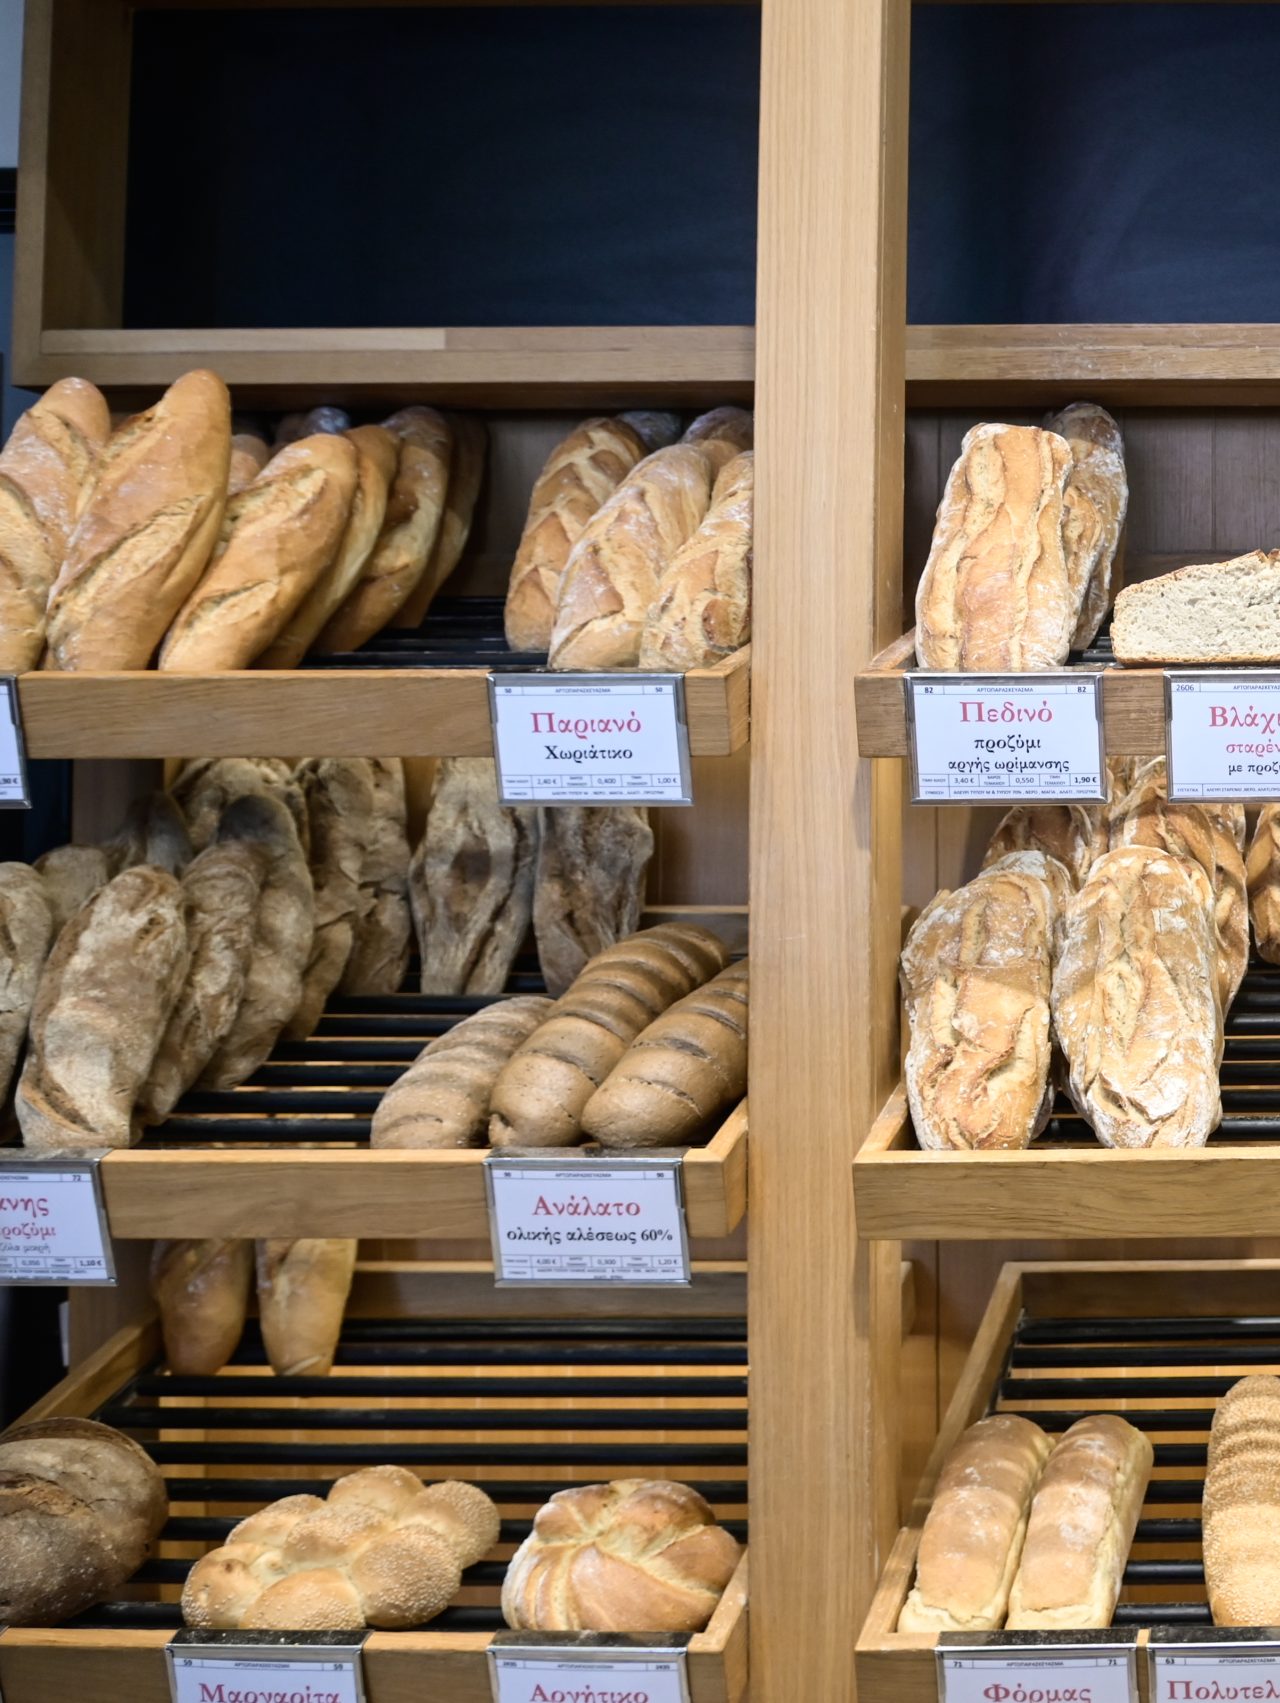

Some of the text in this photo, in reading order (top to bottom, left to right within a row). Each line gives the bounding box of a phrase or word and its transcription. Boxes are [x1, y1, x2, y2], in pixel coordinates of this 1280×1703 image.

[959, 700, 1053, 723] Πεδινό
[530, 711, 641, 739] Παριανό
[974, 734, 1041, 753] προζύμι
[544, 745, 633, 764] Χωριάτικο
[949, 757, 1069, 773] αργής ωρίμανσης
[1229, 763, 1243, 775] με
[532, 1195, 641, 1216] Ανάλατο
[0, 1223, 56, 1240] ροζύμι
[507, 1227, 672, 1245] ολικής αλέσεως 60%
[199, 1683, 340, 1703] Μαργαρίτα
[984, 1683, 1091, 1703] Φόρμας
